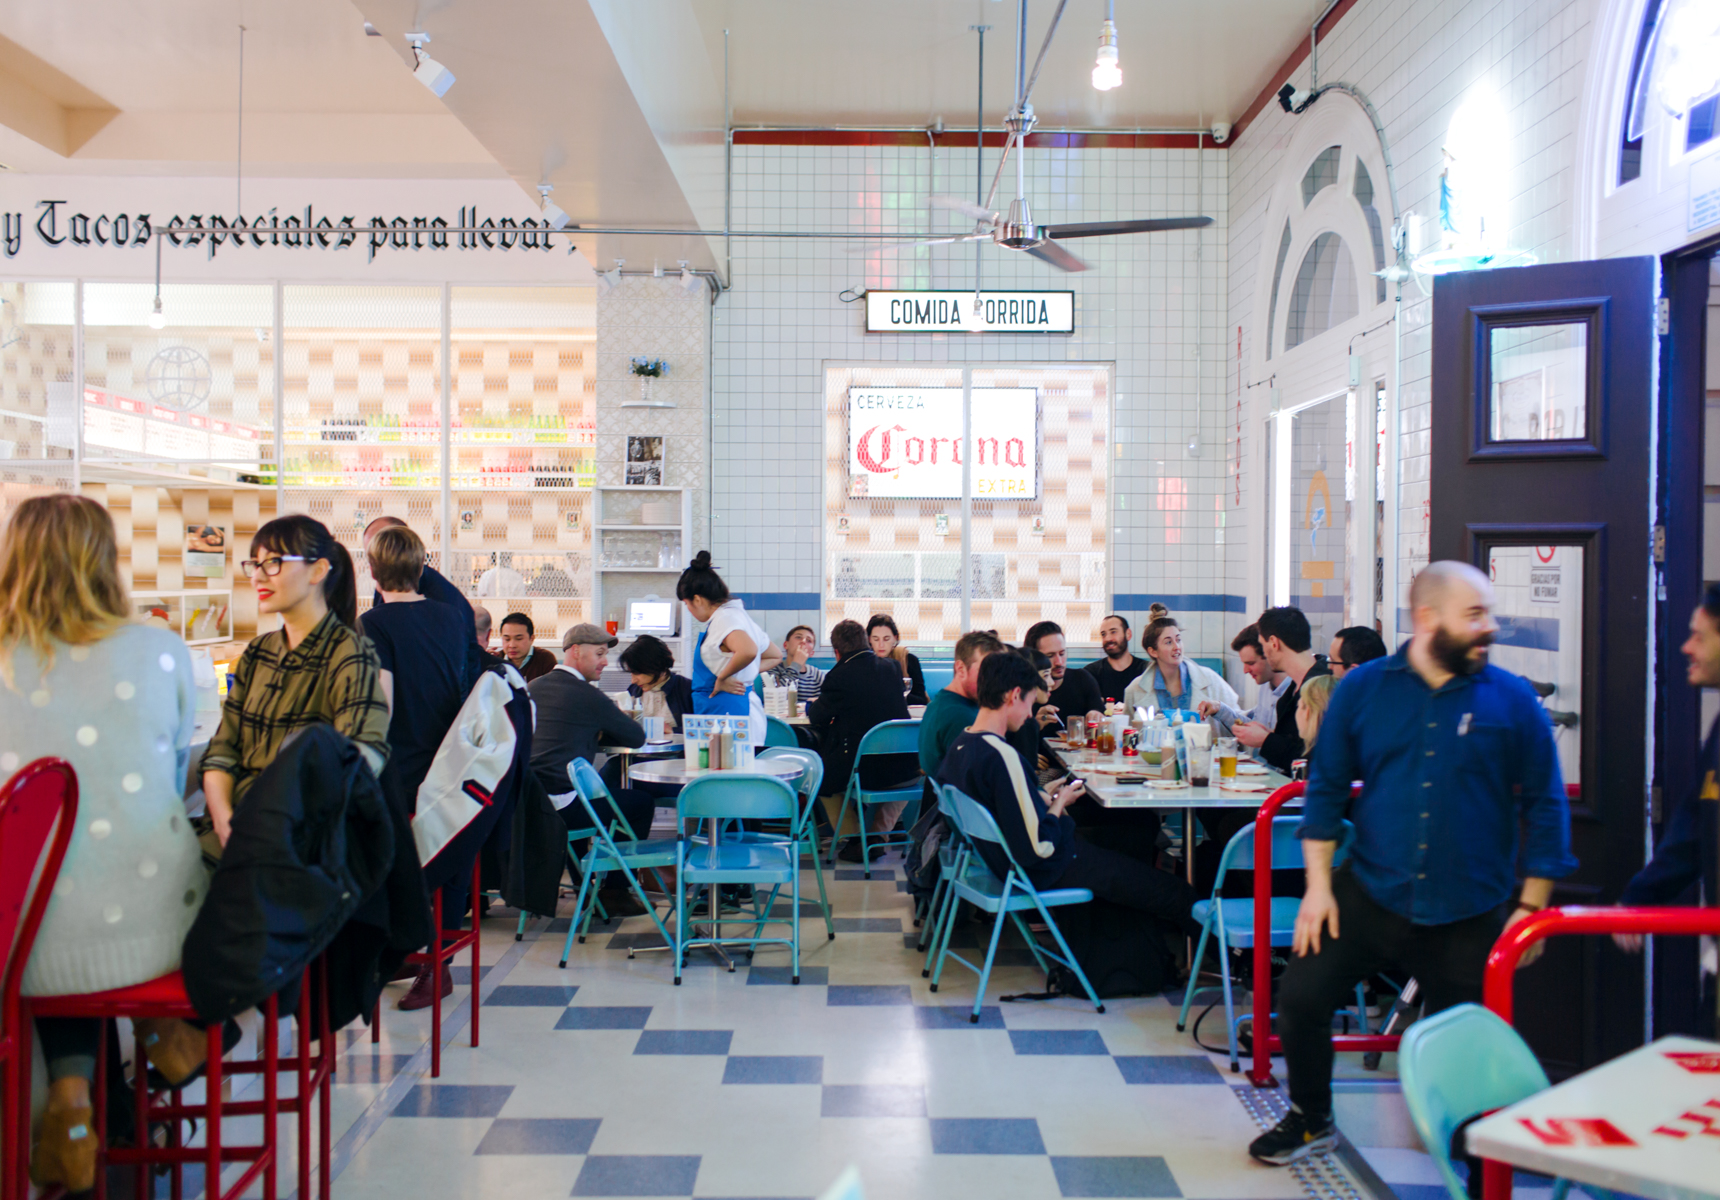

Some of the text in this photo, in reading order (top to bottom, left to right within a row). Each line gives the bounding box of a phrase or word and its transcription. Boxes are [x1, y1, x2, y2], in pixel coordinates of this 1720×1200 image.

[0, 211, 22, 259] y
[34, 200, 152, 248] Tacos
[165, 203, 357, 262] especiales
[367, 214, 449, 264] para
[890, 299, 1049, 324] COMIDA ORRIDA
[857, 395, 925, 409] CERVEZA
[978, 478, 1026, 494] EXTRA
